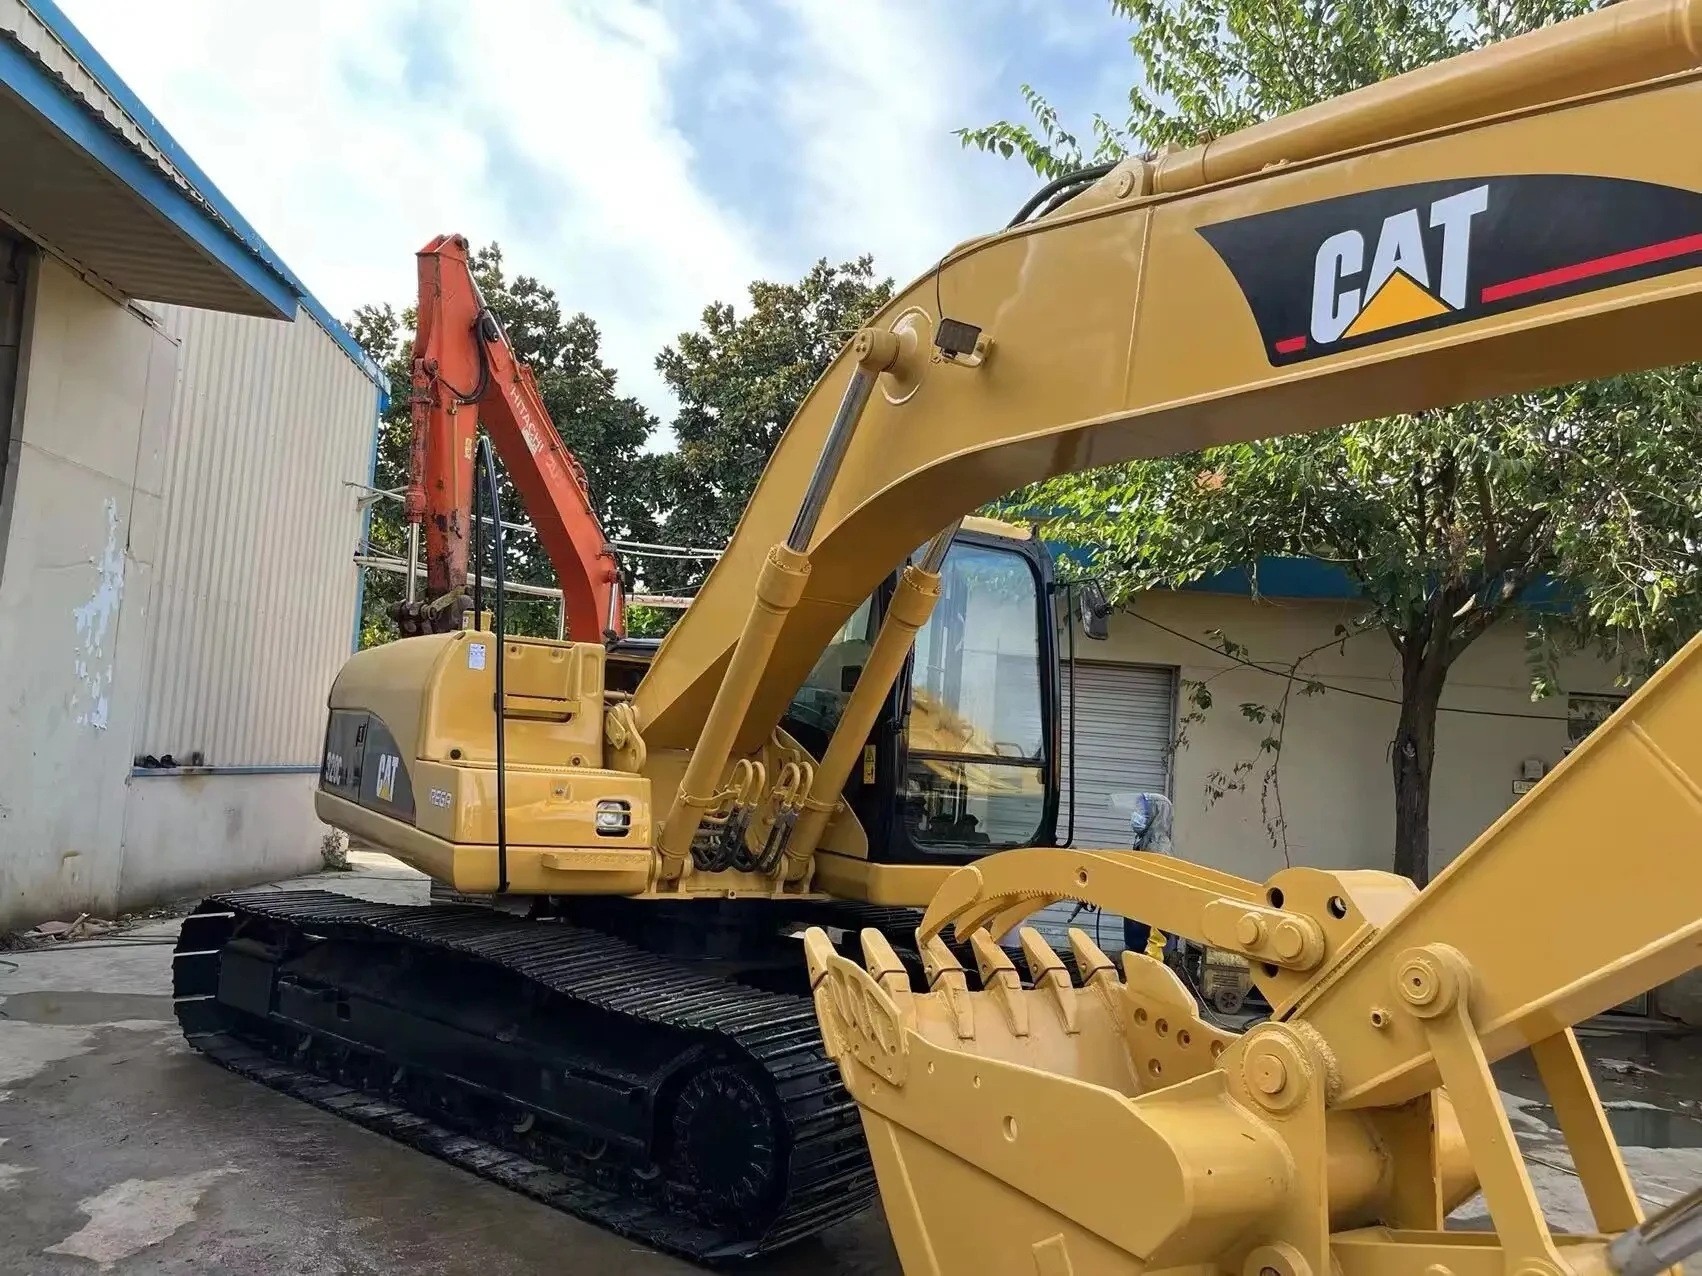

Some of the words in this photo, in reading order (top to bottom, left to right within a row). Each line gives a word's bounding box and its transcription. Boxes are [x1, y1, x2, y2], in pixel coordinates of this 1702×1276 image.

[1310, 184, 1489, 344] CAT
[510, 386, 544, 452] HITACHI
[376, 753, 399, 802] CAT
